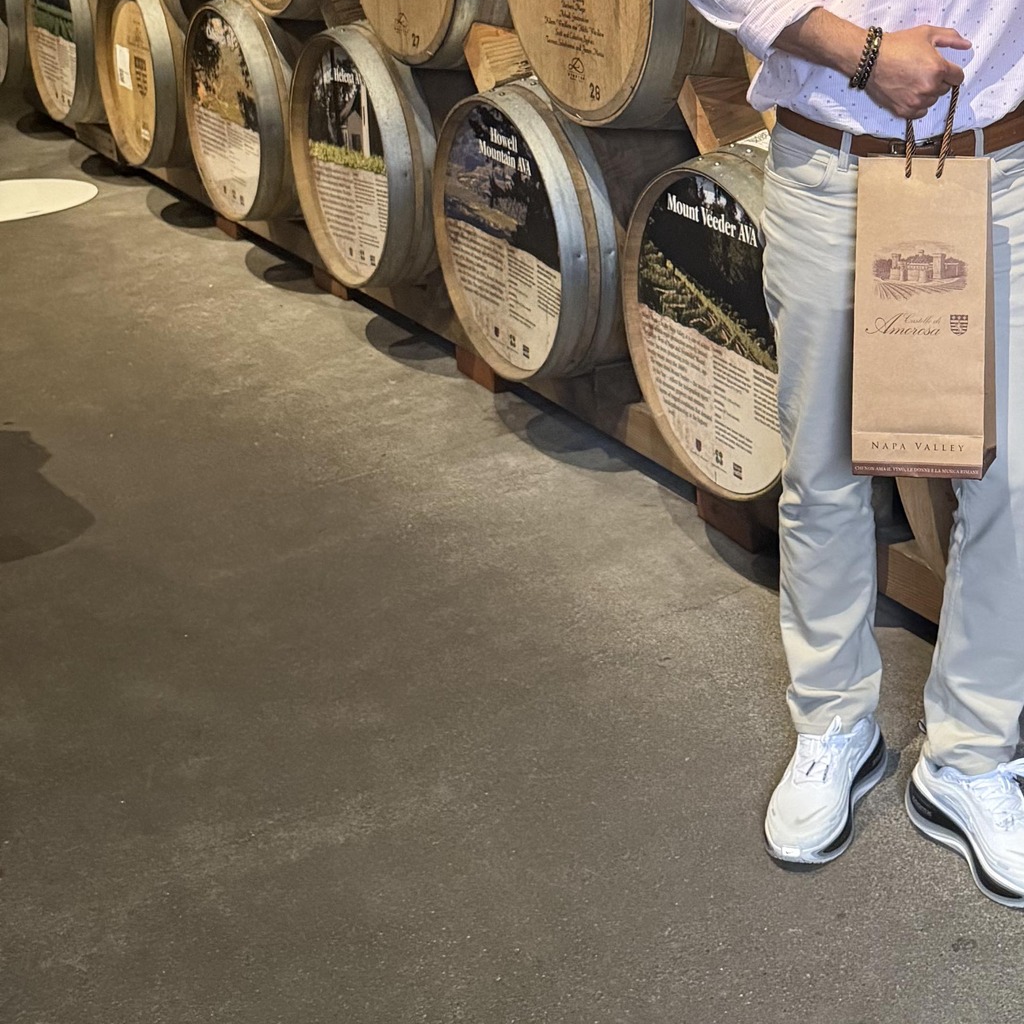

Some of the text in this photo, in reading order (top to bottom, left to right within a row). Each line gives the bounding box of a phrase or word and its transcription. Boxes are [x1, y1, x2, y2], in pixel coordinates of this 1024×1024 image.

[490, 126, 518, 153] Howell
[479, 138, 532, 177] Mountain AVA
[666, 192, 758, 248] Mount Veeder AVA
[864, 312, 941, 336] Amorosa
[871, 441, 964, 452] NAPA VALLEY
